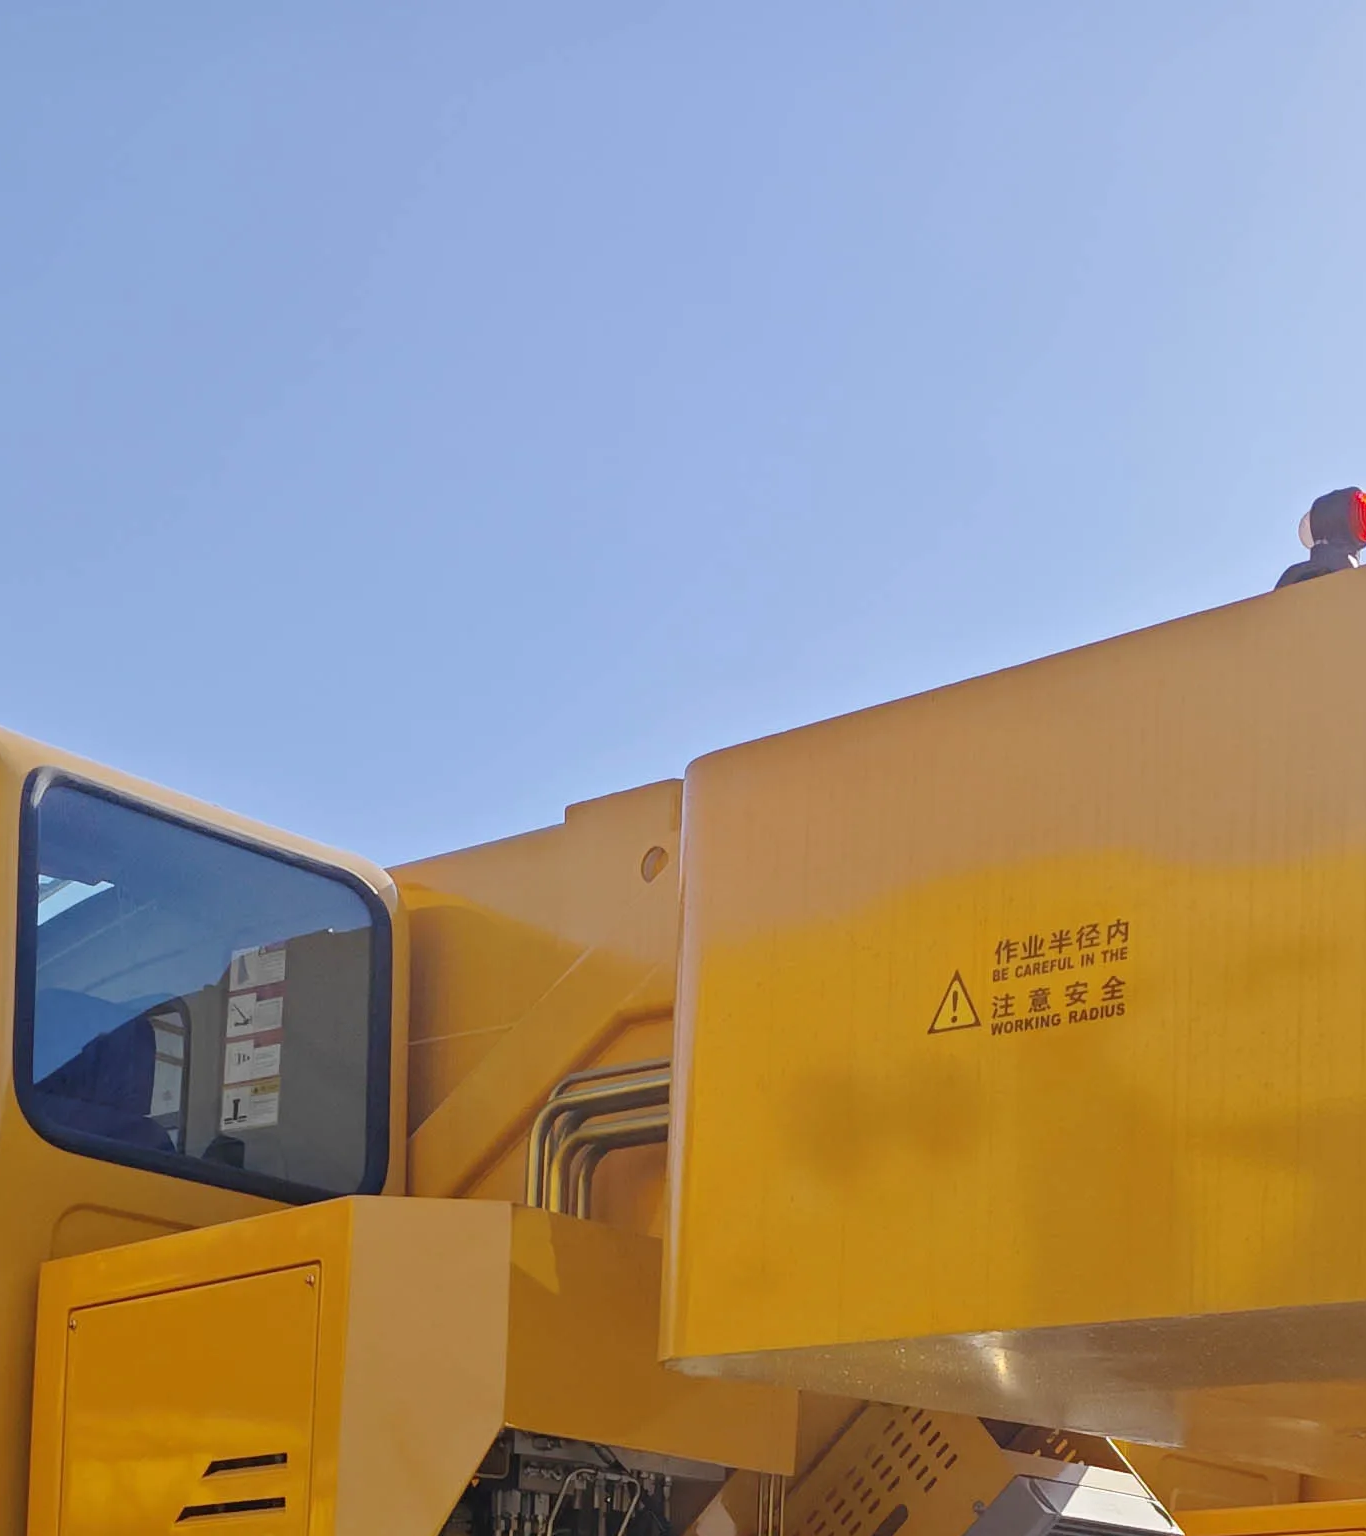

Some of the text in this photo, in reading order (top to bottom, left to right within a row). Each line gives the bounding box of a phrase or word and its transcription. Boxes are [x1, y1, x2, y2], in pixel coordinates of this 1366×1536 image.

[994, 918, 1130, 965] 作业半径内
[992, 946, 1128, 982] BE CAREFUL IN THE
[991, 975, 1126, 1020] 注意安全
[991, 1003, 1126, 1036] WORKING RADIUS
